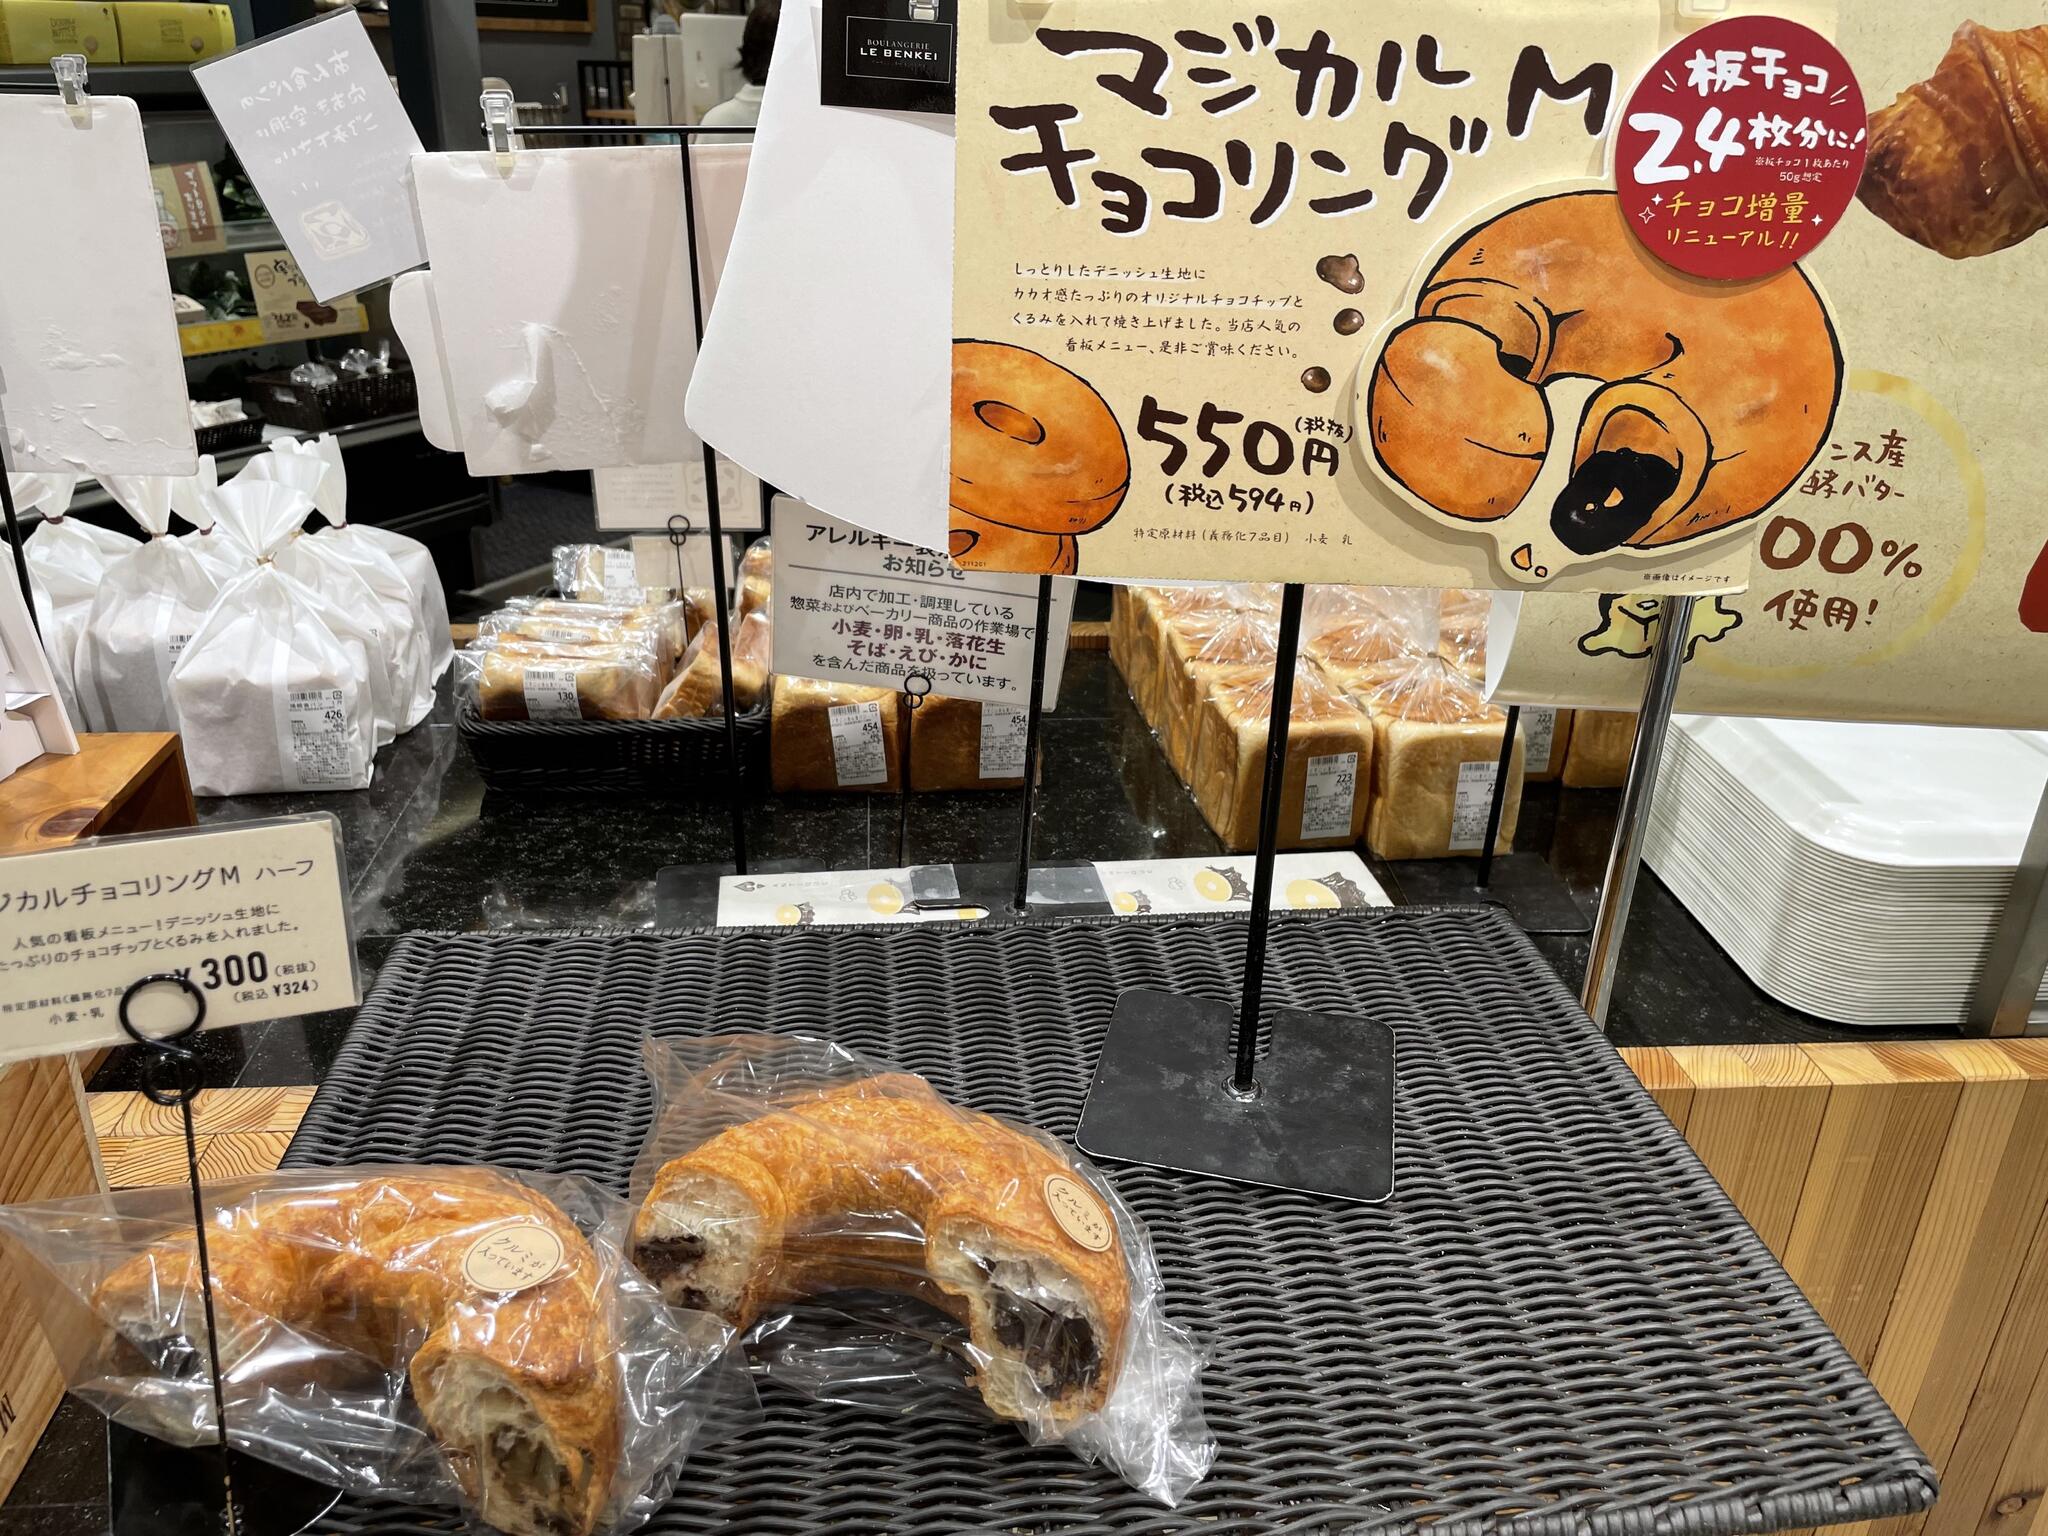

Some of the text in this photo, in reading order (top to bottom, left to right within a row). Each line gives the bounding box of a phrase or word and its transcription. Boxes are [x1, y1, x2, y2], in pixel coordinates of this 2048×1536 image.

[860, 47, 938, 61] LE BENKEI
[867, 39, 929, 50] BOULANGERIE
[1036, 15, 1614, 138] マジカル M
[1684, 46, 1830, 99] 板チョコ
[988, 103, 1489, 234] チョコリング
[1779, 171, 1823, 184] 50g想定
[1665, 191, 1809, 225] チョコ増量
[1667, 227, 1801, 250] リニューアル!!
[1014, 262, 1207, 281] しっとりしたデニッシュ生地に
[1012, 287, 1304, 309] カカオ感たっぷりのオリジナルチョコチップと
[1012, 313, 1301, 334] くるみを入れて焼き上げました。当店人気の
[1064, 337, 1300, 360] 看板メニュー、是非ご賞味ください。
[1305, 533, 1328, 545] 小麦
[883, 553, 966, 581] お知らせ
[828, 584, 1015, 620] 店内で加工・調理している
[790, 596, 1050, 641] 惣菜およびベーカリー商品の作業場で
[831, 618, 1006, 656] 小麦・卵・乳・落花生
[847, 640, 988, 671] そば・えび・かに
[812, 655, 1017, 692] を含んだ商品を扱っています。
[558, 691, 574, 701] 130
[324, 710, 343, 720] 426
[1011, 715, 1026, 724] 454
[862, 722, 878, 732] 454
[1336, 773, 1353, 784] 223
[255, 859, 314, 881] ハーフ
